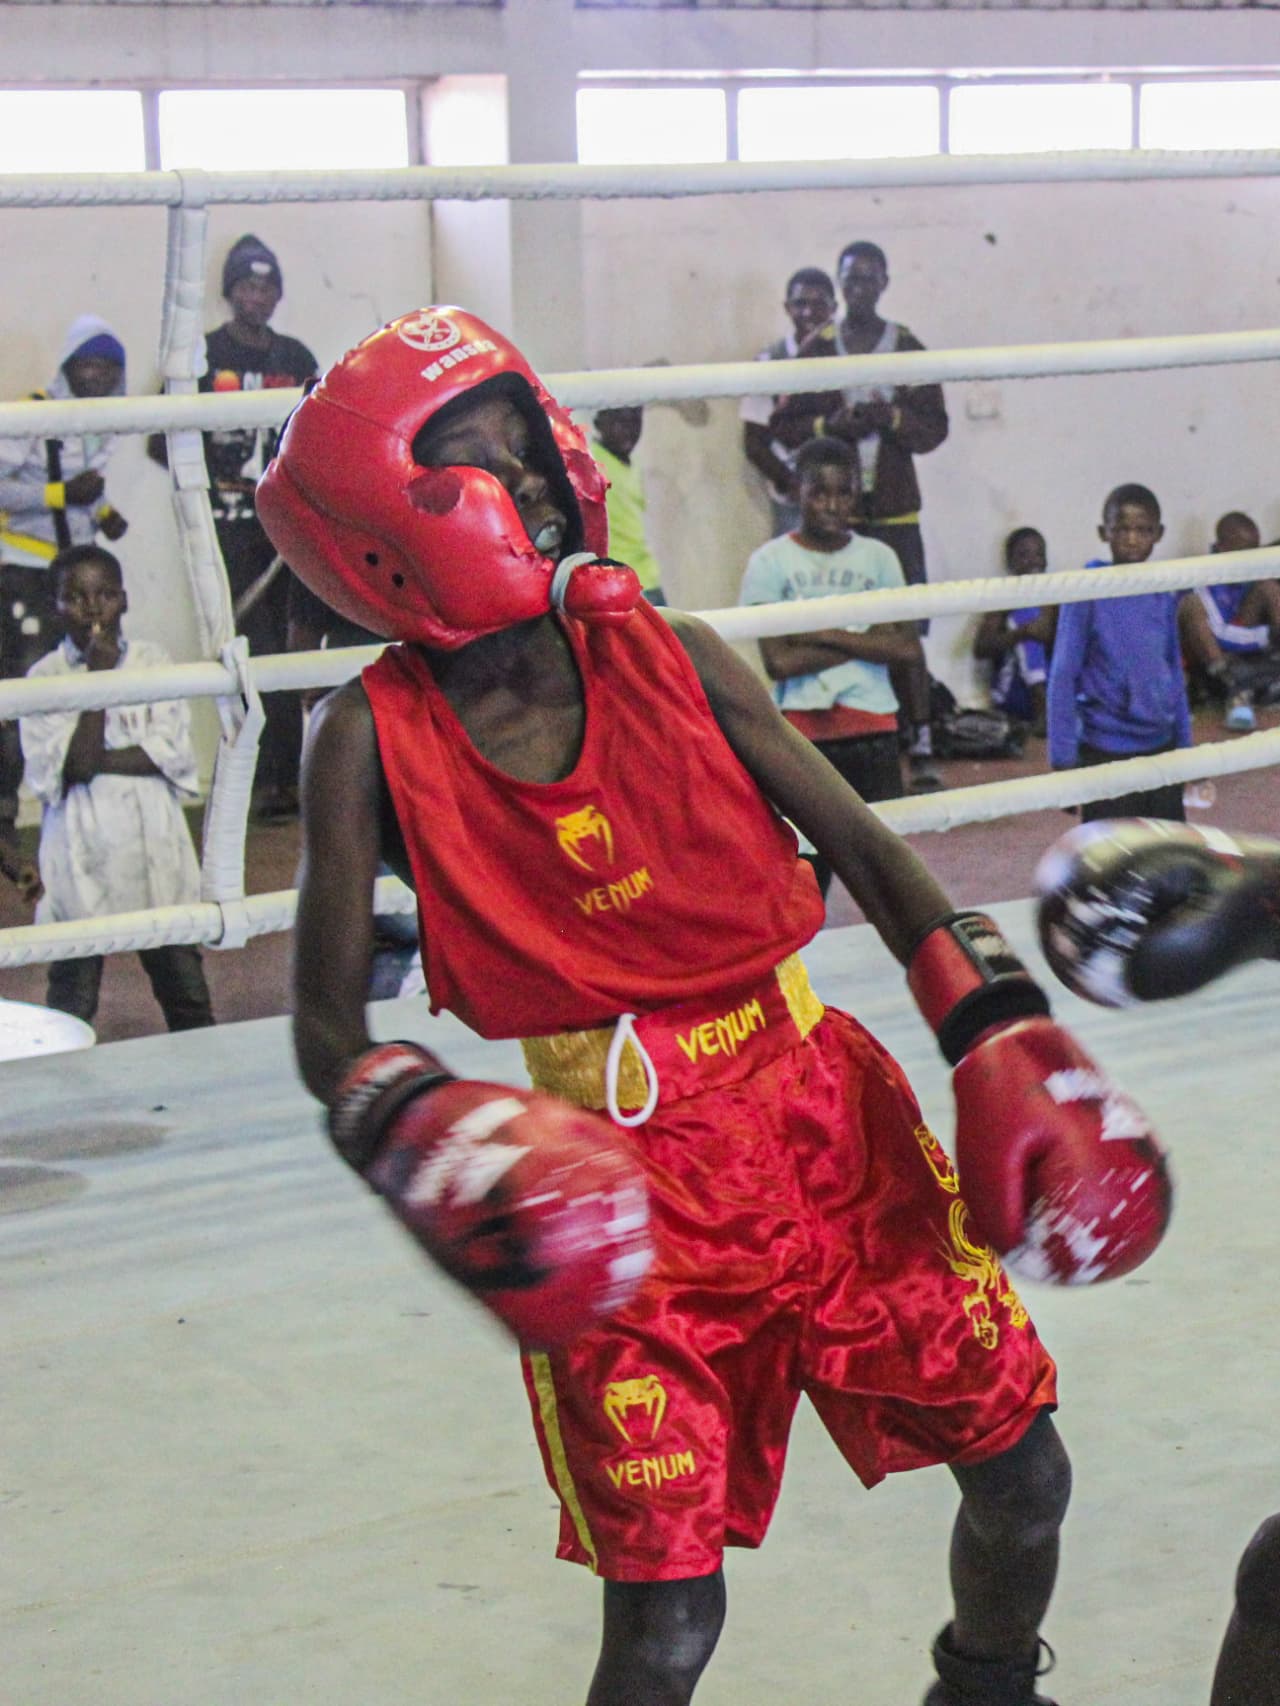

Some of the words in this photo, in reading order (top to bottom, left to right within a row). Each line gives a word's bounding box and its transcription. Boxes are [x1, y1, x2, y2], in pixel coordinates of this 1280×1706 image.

[574, 866, 656, 915] VENUM
[675, 998, 767, 1065] VENUM
[605, 1449, 696, 1489] VENUM
